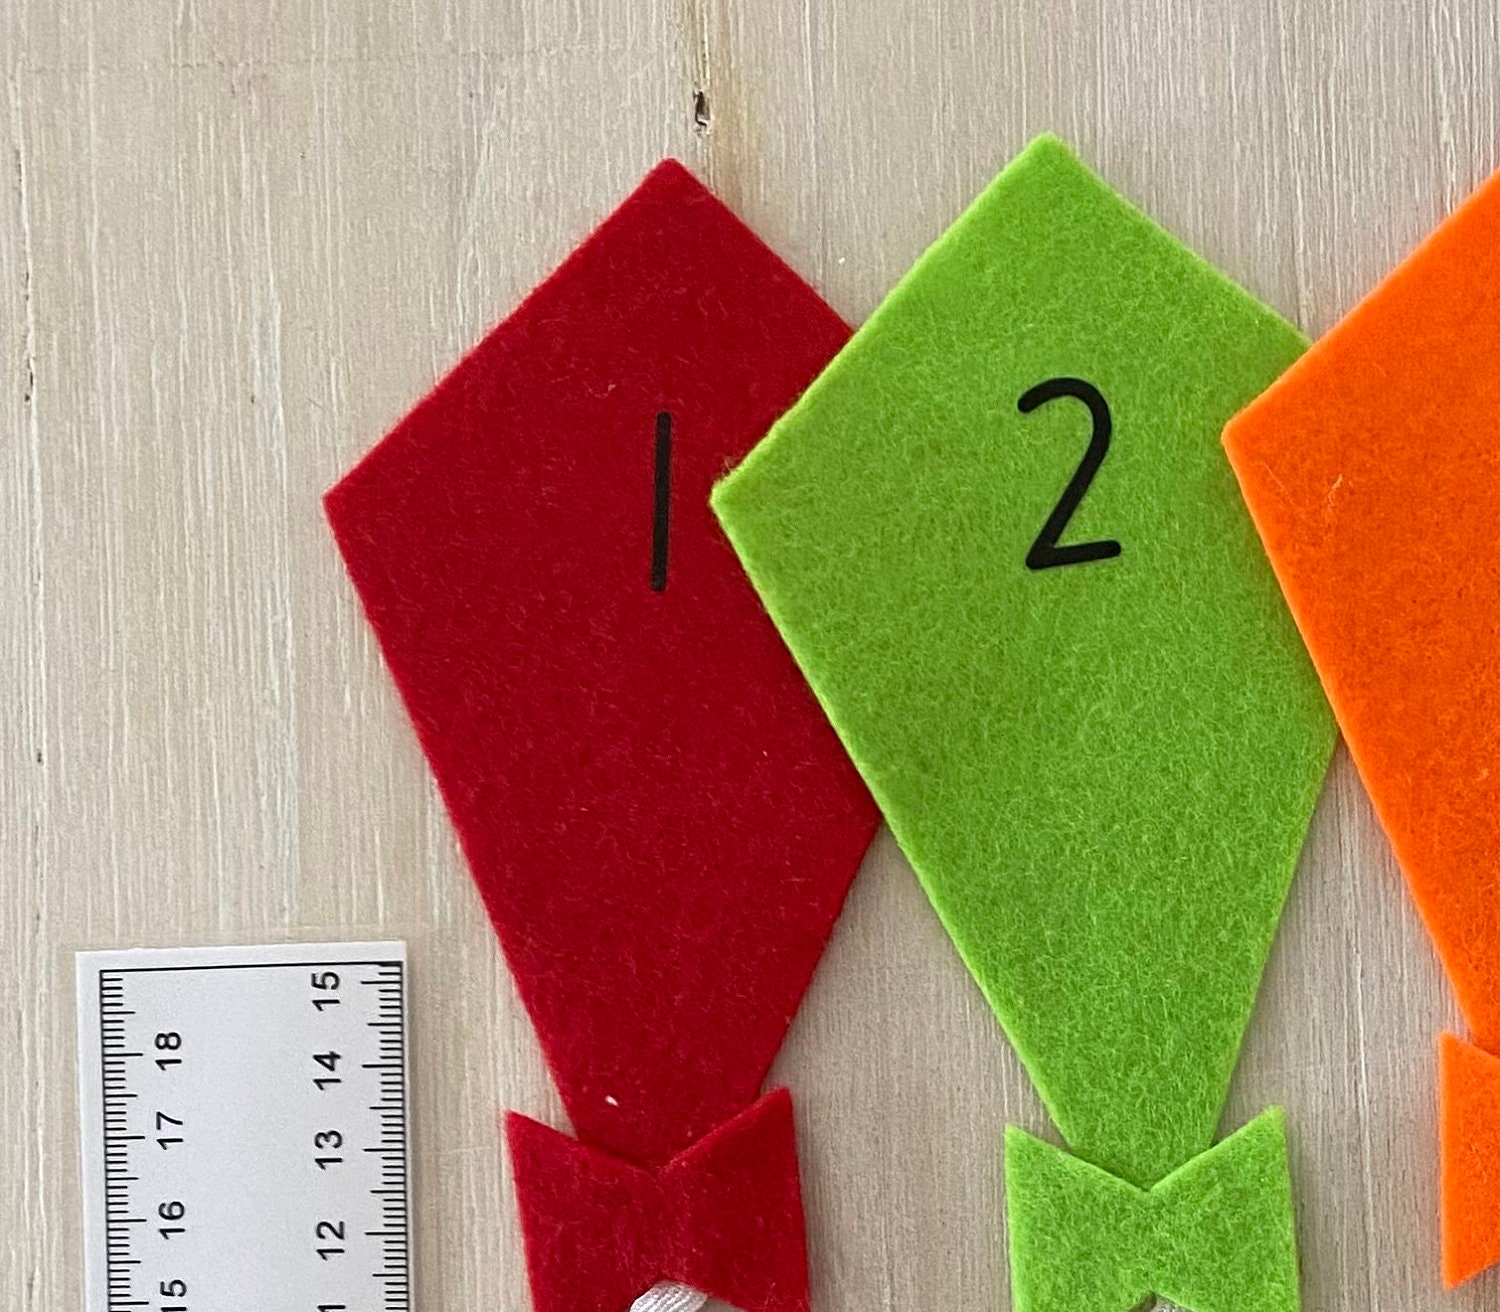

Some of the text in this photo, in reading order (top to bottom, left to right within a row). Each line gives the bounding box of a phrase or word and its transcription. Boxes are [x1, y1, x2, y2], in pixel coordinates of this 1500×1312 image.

[1017, 377, 1122, 572] 2
[649, 411, 673, 593] 1
[310, 971, 341, 1012] 15
[154, 1031, 183, 1071] 18
[312, 1050, 342, 1091] 14
[155, 1111, 184, 1151] 17
[314, 1129, 344, 1171] 13
[158, 1201, 186, 1240] 16
[315, 1220, 346, 1261] 12
